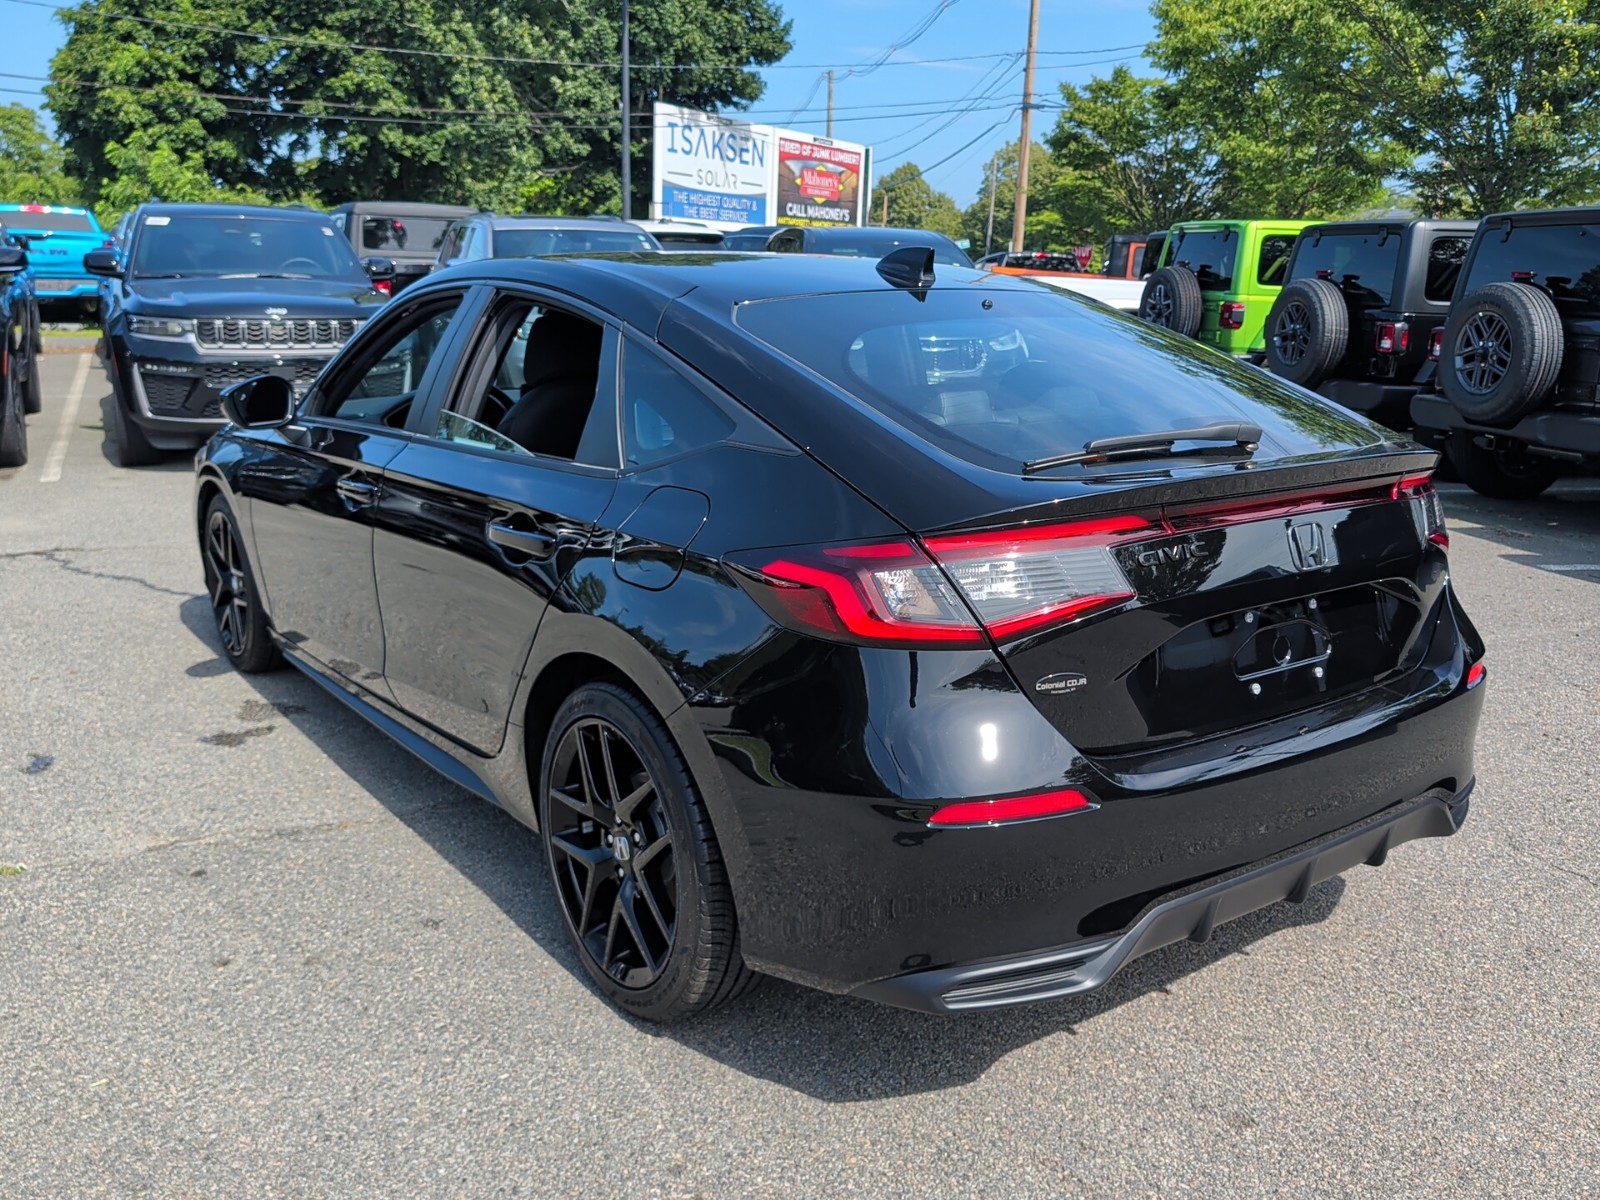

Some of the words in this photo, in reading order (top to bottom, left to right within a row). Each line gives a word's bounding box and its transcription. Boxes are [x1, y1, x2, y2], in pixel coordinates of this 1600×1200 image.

[667, 122, 765, 168] ISAKSEN
[780, 140, 801, 154] TIRED
[801, 145, 813, 156] OF
[812, 147, 831, 160] JUNK
[697, 168, 738, 190] SOLAR
[673, 190, 689, 203] THE
[689, 192, 721, 207] HIGHEST
[722, 196, 751, 210] QUALITY
[683, 205, 698, 218] THE
[699, 207, 718, 219] BEST
[719, 209, 749, 222] SERVICE
[786, 203, 807, 217] CALL
[807, 205, 850, 222] MAHONEY'S
[1138, 541, 1209, 567] CIVIC
[1035, 680, 1066, 691] Colonial
[1066, 678, 1087, 687] CDJR
